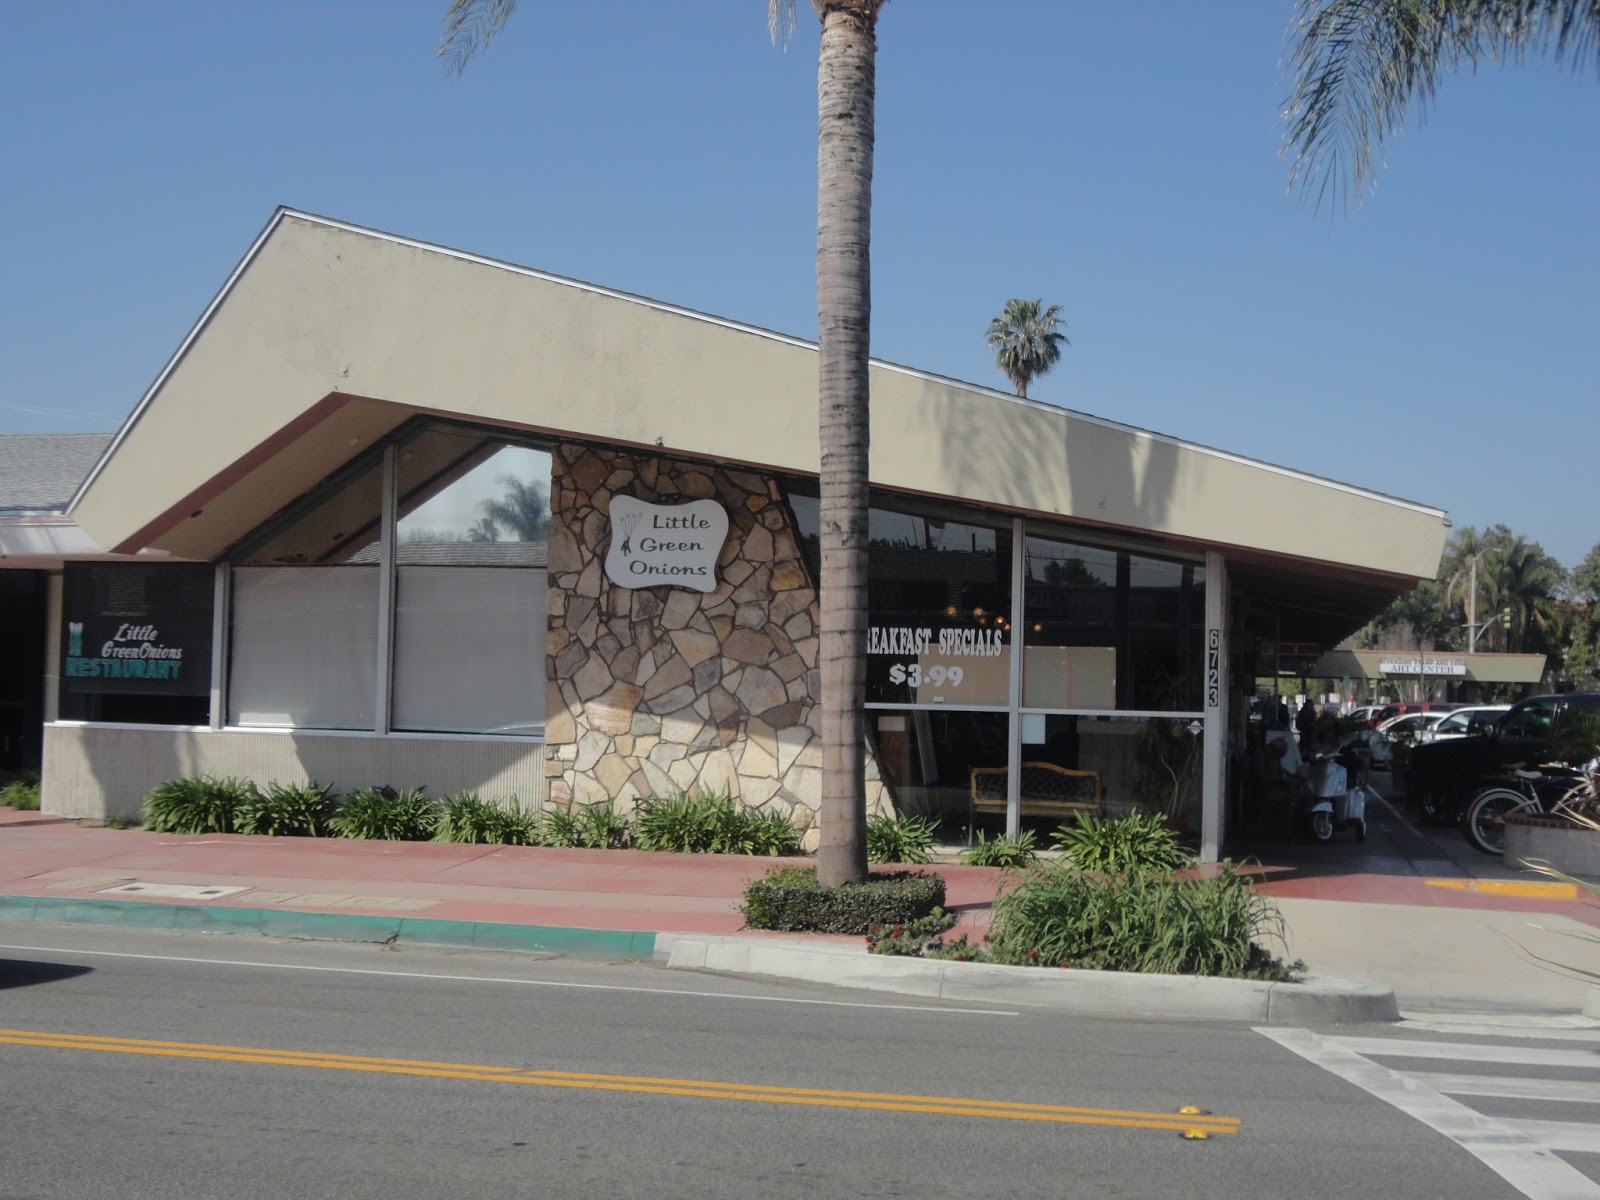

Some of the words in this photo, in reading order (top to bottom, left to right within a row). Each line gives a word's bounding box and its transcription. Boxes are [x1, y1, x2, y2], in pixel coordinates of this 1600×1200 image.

[652, 513, 711, 529] Little
[640, 537, 704, 552] Green
[629, 560, 707, 576] Onions
[113, 623, 158, 642] Little
[867, 626, 932, 656] EAKFAST
[938, 628, 1003, 657] SPECIALS
[65, 657, 183, 680] RESTAURANT
[889, 663, 964, 688] $3.99
[1209, 629, 1220, 708] 6723
[1391, 665, 1410, 673] ART
